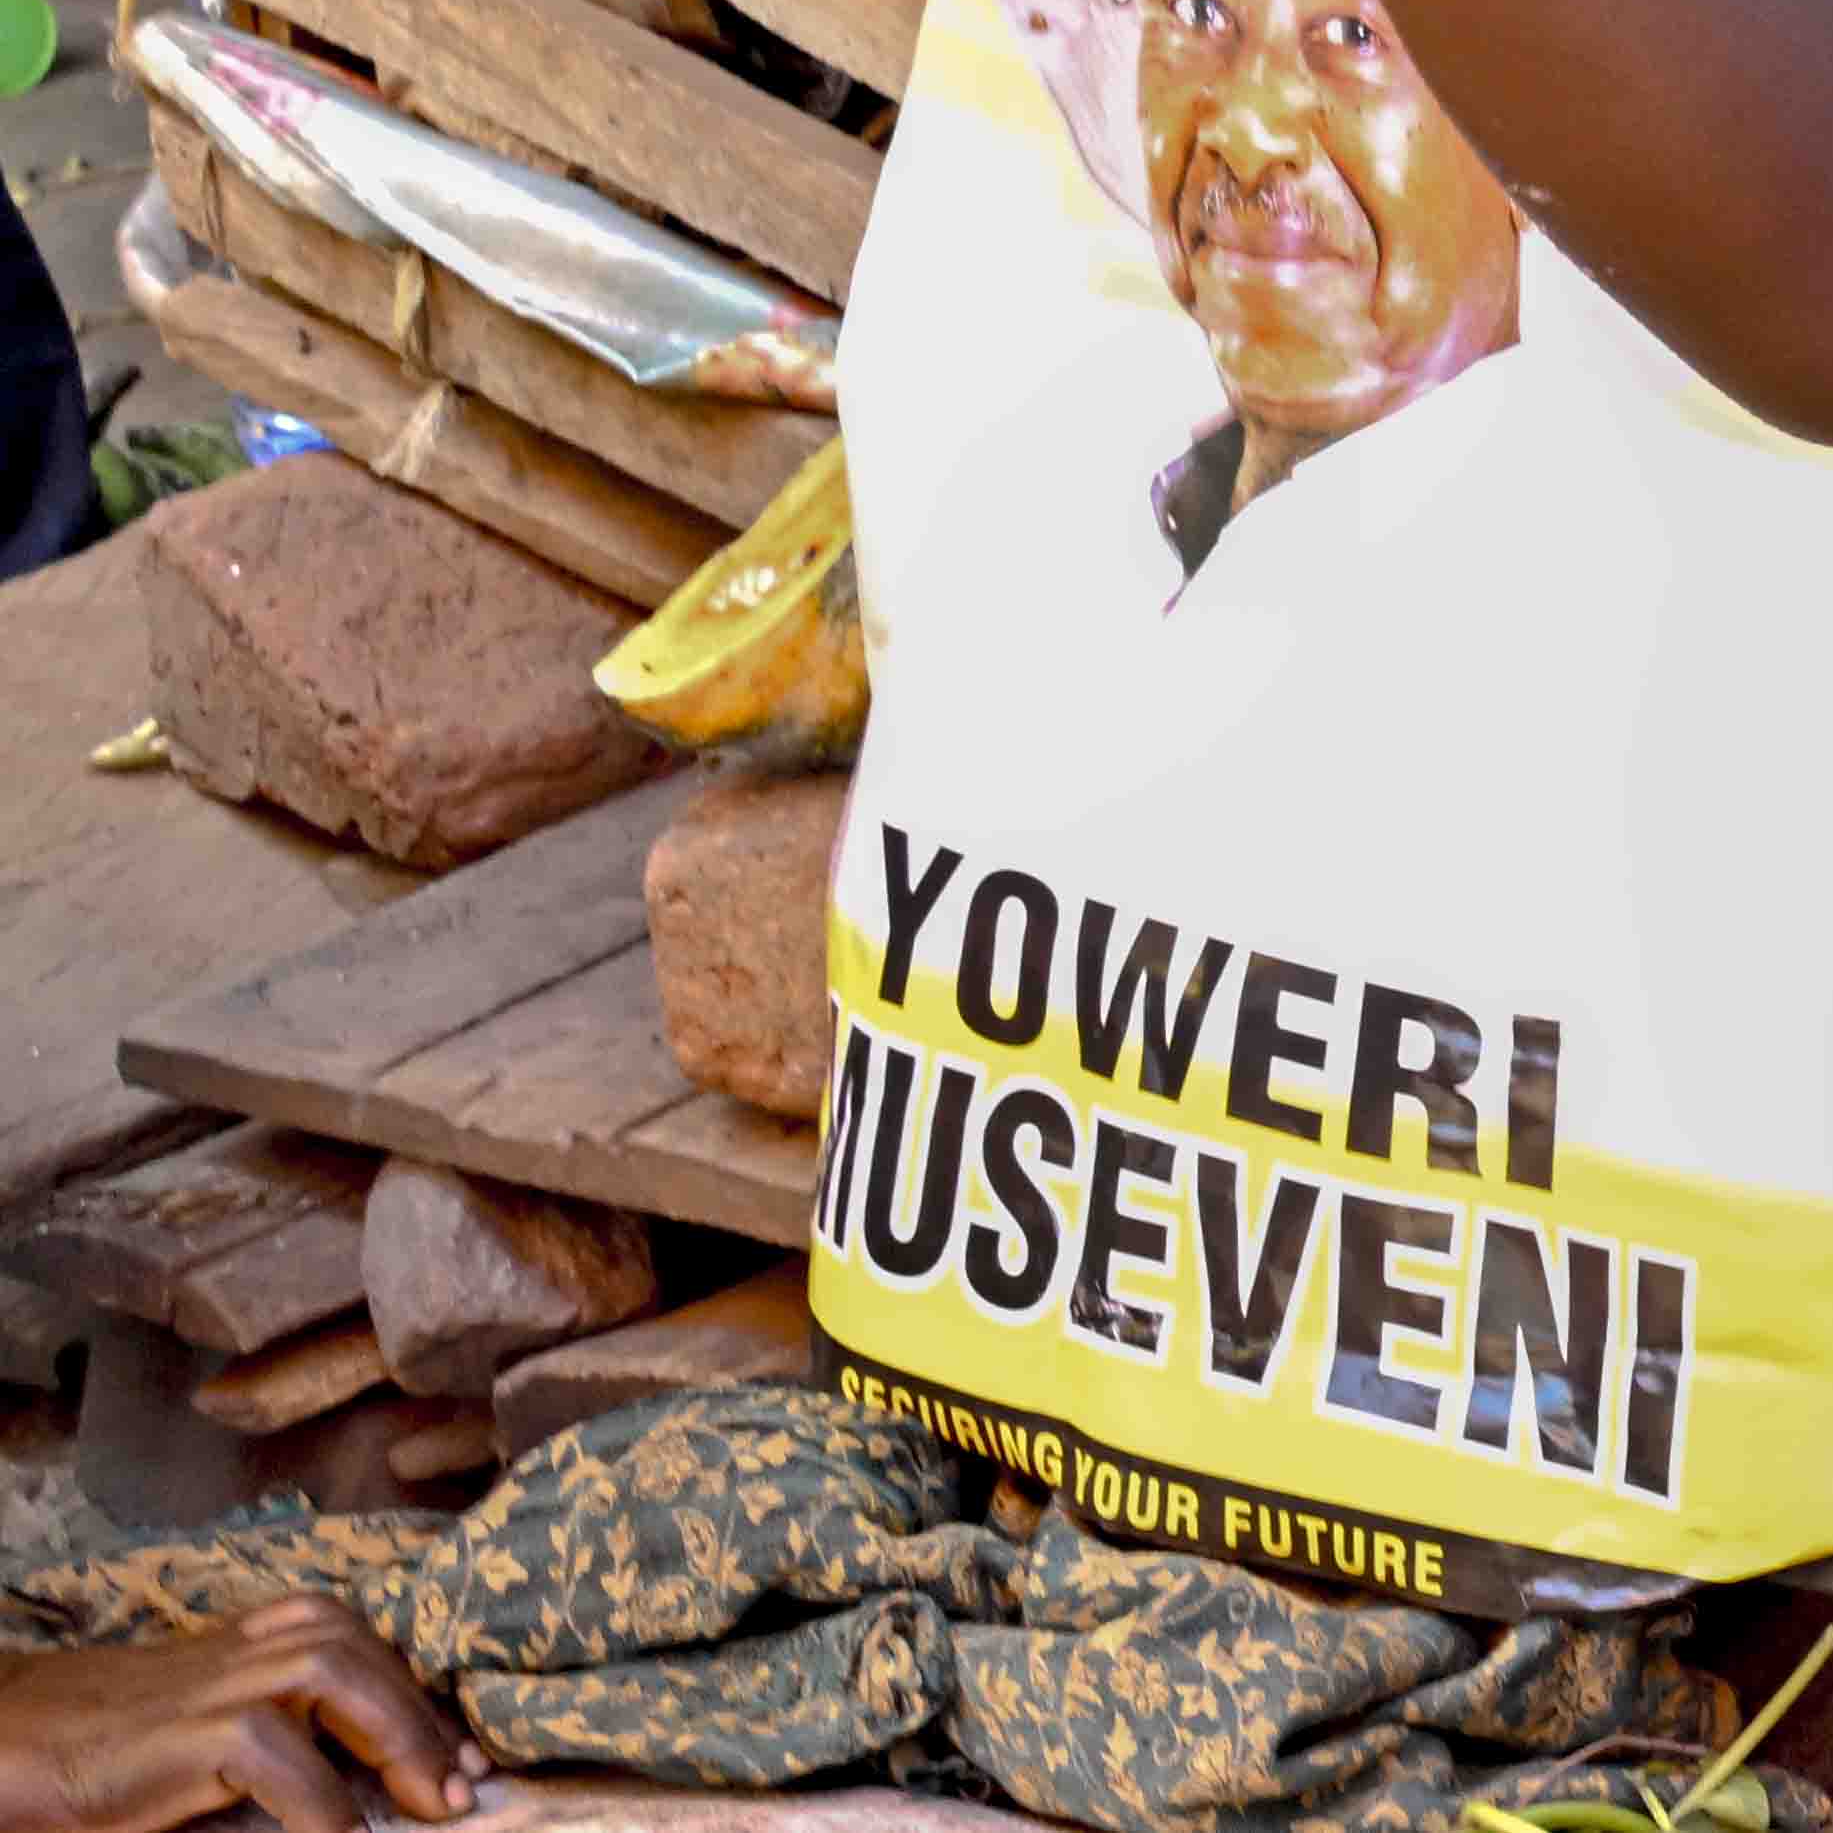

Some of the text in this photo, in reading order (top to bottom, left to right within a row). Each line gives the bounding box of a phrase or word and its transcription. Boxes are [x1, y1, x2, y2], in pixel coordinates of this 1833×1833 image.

[878, 821, 1561, 1194] YOWERI
[818, 994, 1687, 1500] MUSEVENI
[1071, 1445, 1201, 1542] YOUR
[1222, 1493, 1447, 1599] FUTURE
